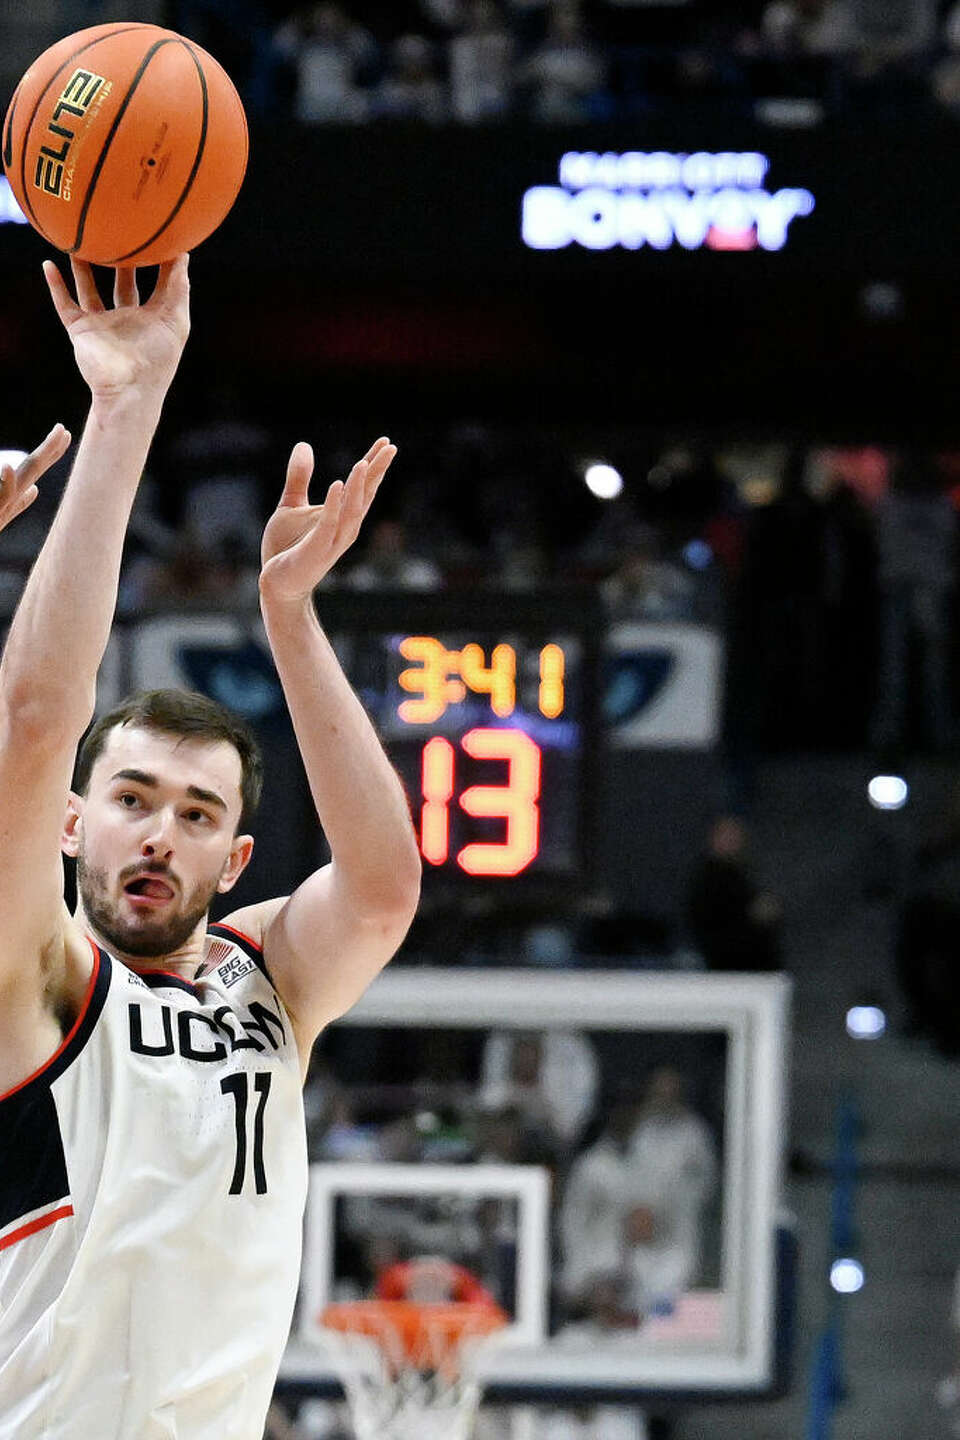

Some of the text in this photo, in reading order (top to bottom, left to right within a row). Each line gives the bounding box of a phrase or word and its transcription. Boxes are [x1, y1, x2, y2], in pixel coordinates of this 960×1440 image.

[34, 68, 106, 197] ELITE
[397, 636, 565, 724] 3:41
[421, 727, 541, 876] 13
[218, 955, 241, 978] BIG
[222, 960, 254, 986] EAST
[220, 1072, 271, 1195] 11
